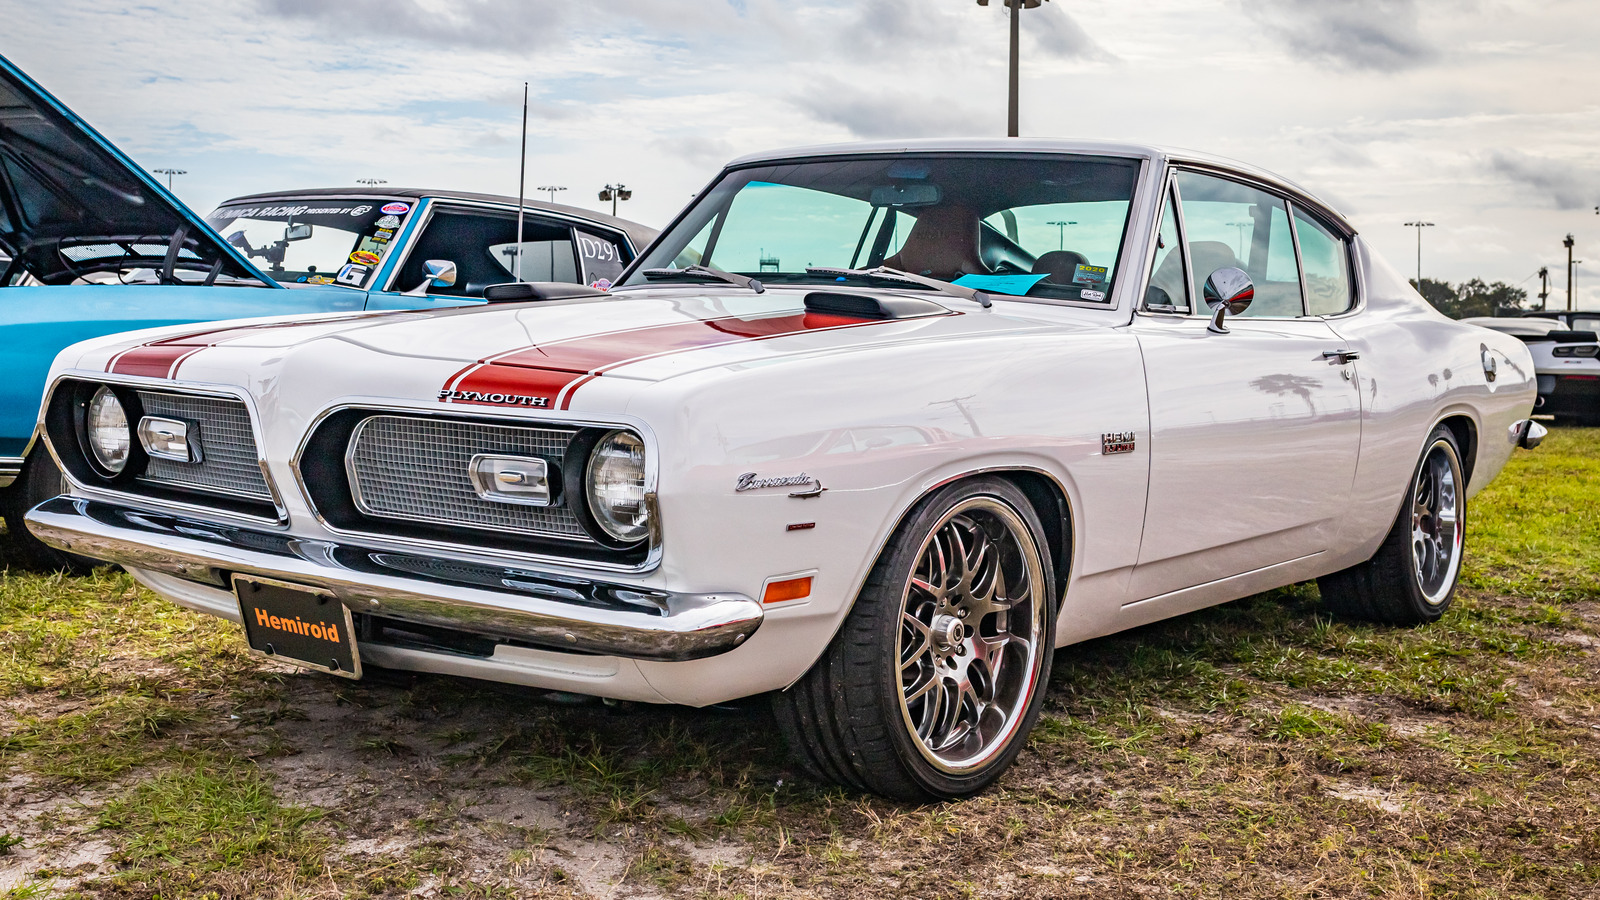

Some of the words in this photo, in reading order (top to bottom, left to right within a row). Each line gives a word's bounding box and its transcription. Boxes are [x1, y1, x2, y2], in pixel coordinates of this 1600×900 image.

[256, 206, 308, 217] RACING
[580, 237, 623, 263] D291
[1079, 265, 1105, 273] 2020
[437, 389, 549, 407] PLYMOUTH
[1102, 431, 1135, 444] HEMI
[736, 472, 813, 492] Barracuda
[254, 607, 340, 643] Hemiroid
